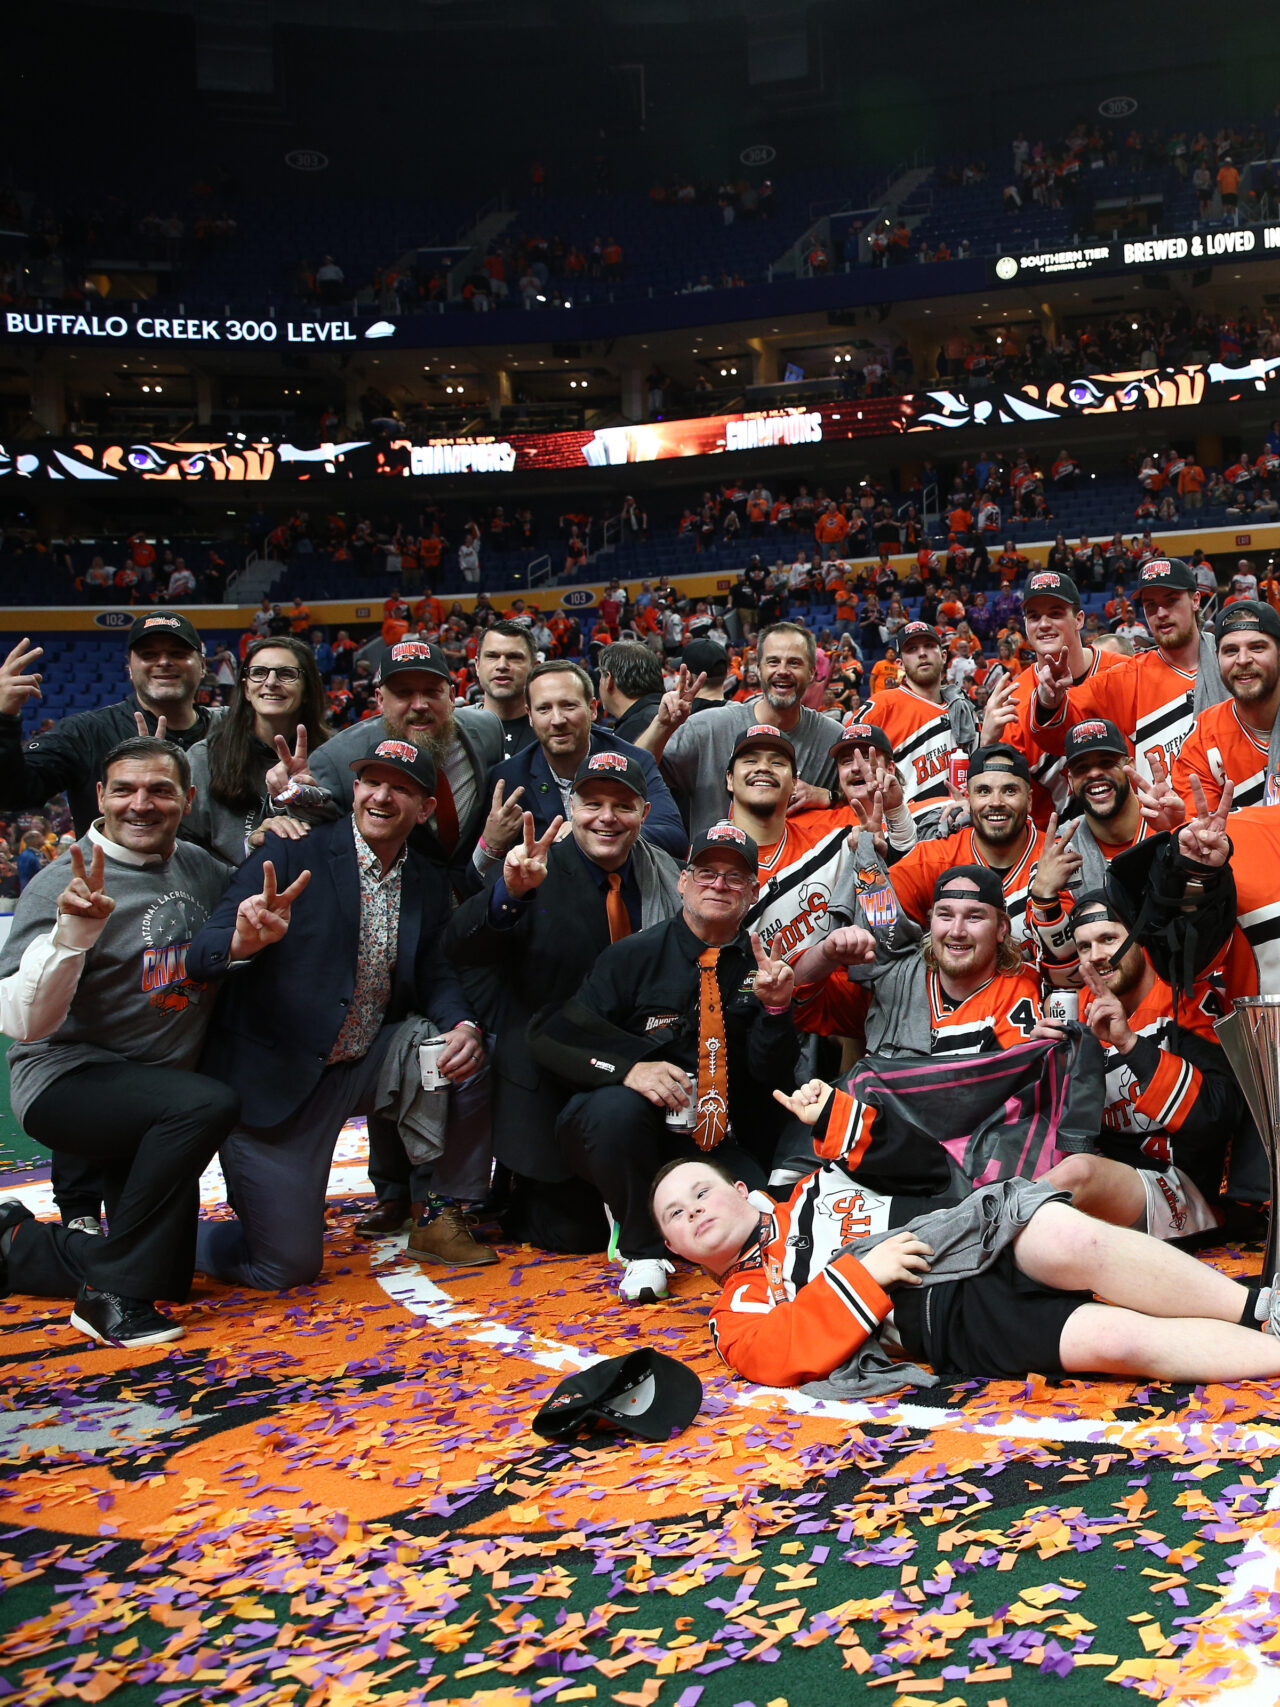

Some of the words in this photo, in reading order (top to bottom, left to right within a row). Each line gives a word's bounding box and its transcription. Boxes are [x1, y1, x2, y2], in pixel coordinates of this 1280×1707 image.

[1123, 237, 1188, 264] BREWED
[1191, 236, 1204, 257] &
[1206, 231, 1255, 255] LOVED
[1264, 226, 1280, 248] IN
[1020, 251, 1083, 269] SOUTHERN
[1083, 247, 1110, 261] TIER
[6, 313, 128, 337] BUFFALO
[136, 318, 221, 340] CREEK
[226, 320, 278, 342] 300
[288, 321, 357, 342] LEVEL
[570, 591, 586, 601] 103
[106, 614, 123, 626] 102
